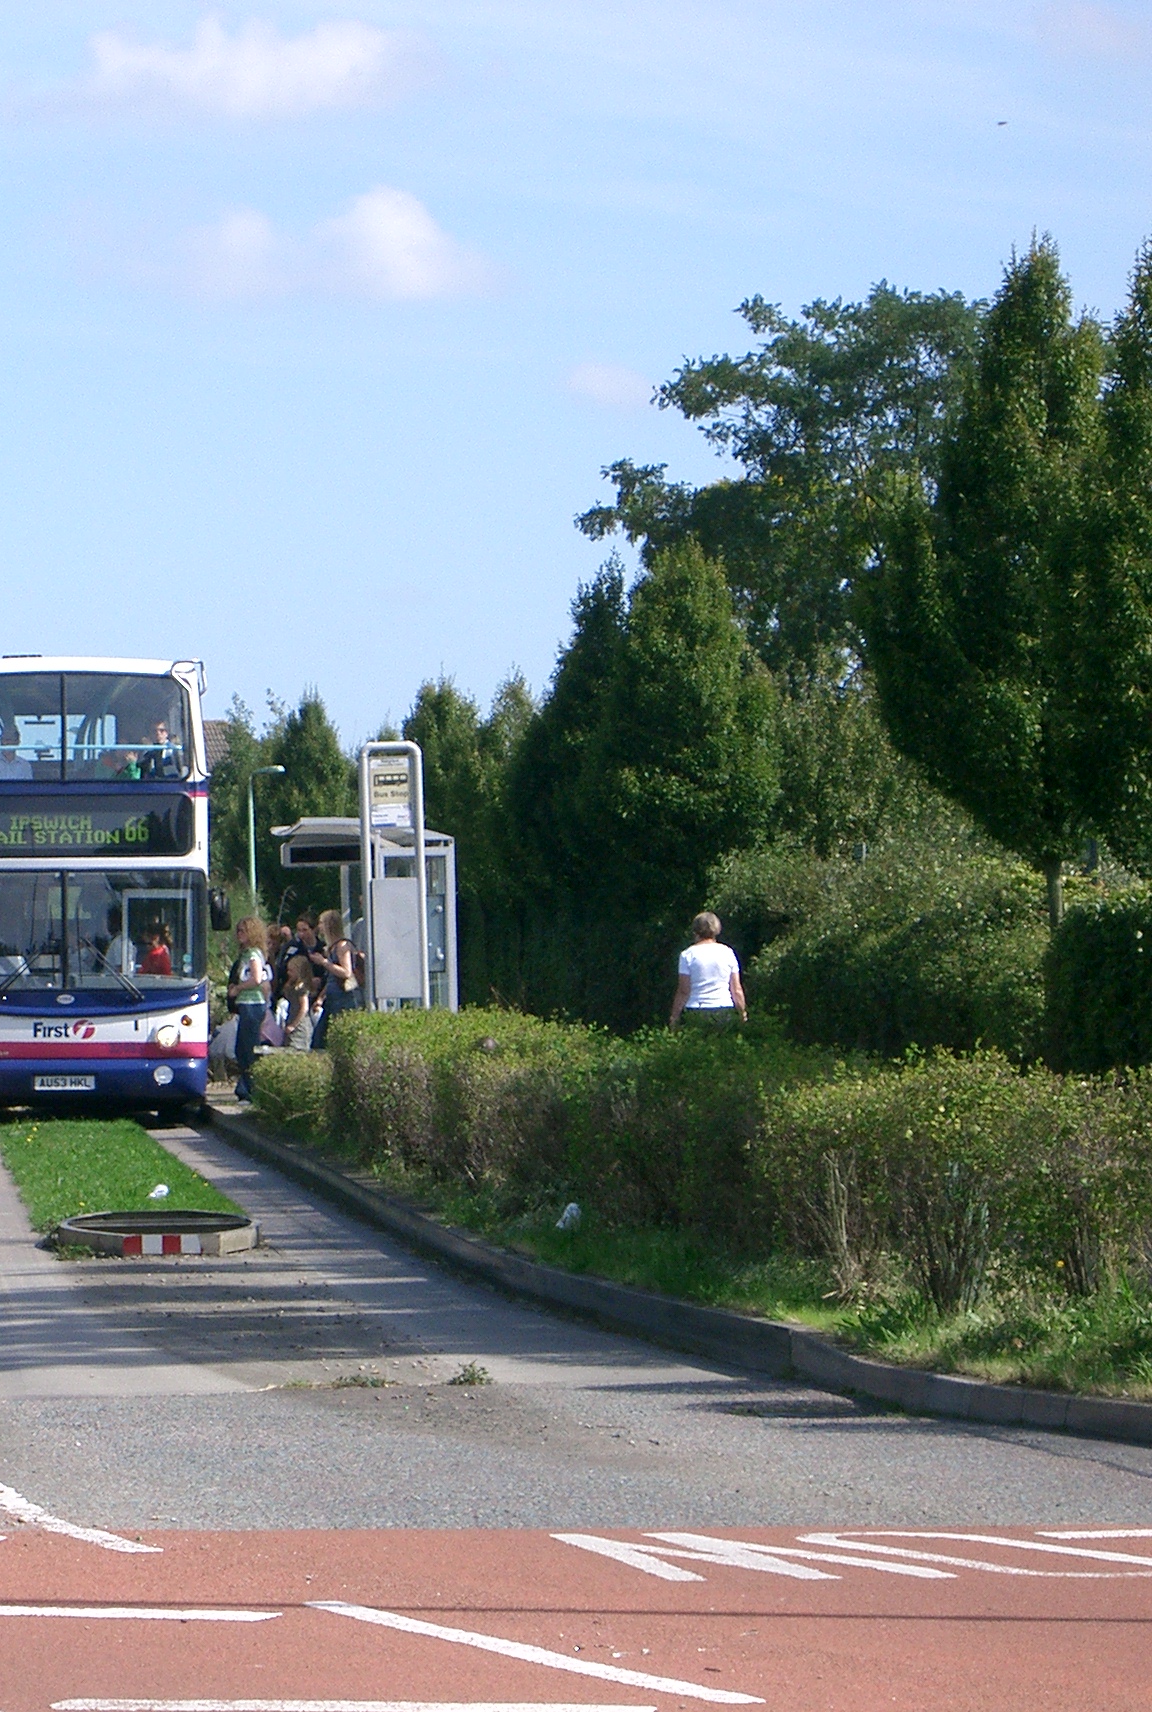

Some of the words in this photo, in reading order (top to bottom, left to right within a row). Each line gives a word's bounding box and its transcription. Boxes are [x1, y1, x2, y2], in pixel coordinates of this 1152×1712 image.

[10, 815, 92, 831] IPSWICH
[124, 816, 150, 843] 66
[34, 830, 120, 845] STATION
[33, 1022, 71, 1039] First
[39, 1077, 67, 1088] AU53
[70, 1077, 91, 1088] HKL
